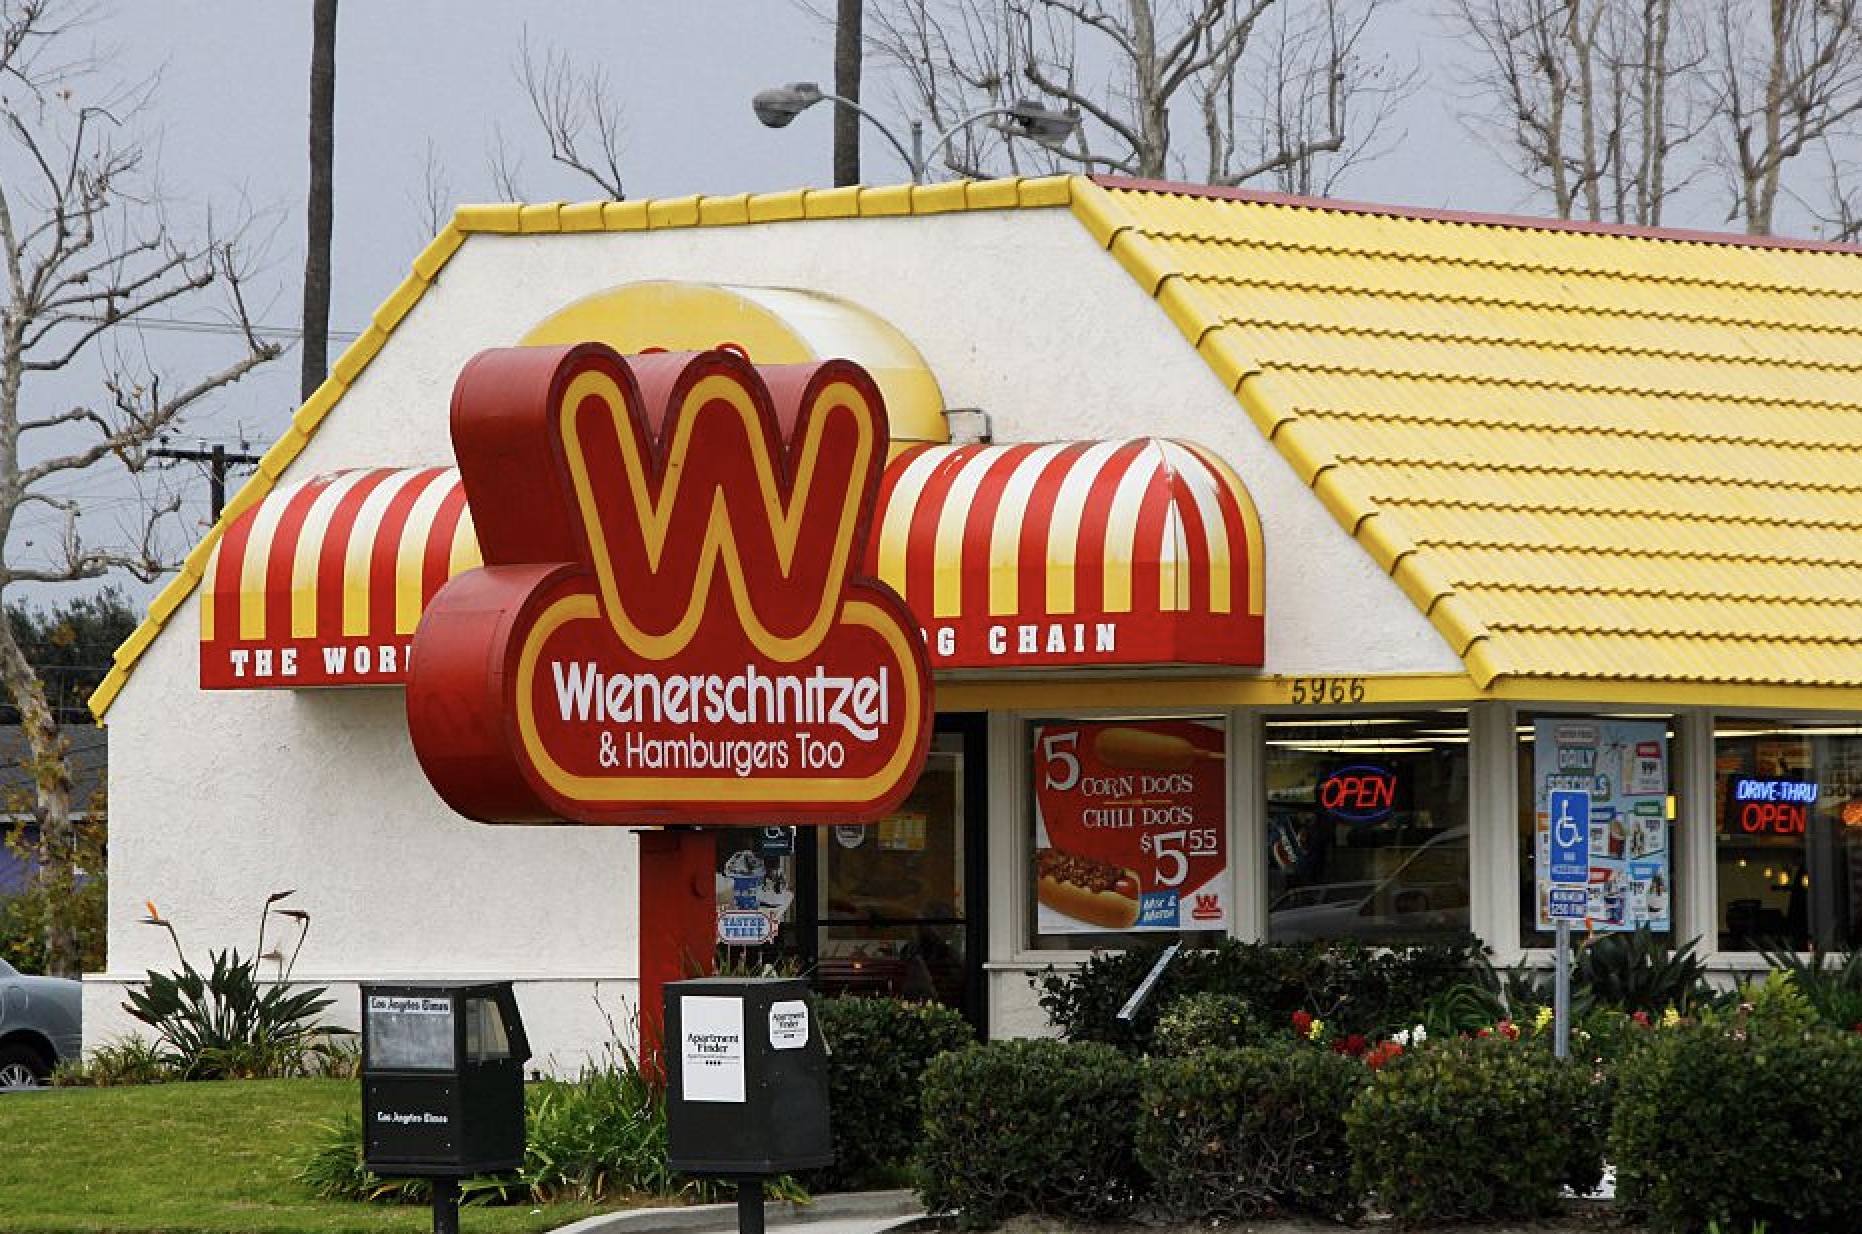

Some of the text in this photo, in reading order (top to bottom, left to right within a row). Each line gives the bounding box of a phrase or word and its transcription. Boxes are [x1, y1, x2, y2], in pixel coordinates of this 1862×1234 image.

[560, 370, 873, 662] W
[919, 623, 1117, 656] G CHAIN
[230, 648, 297, 677] THE
[552, 661, 889, 741] Wienerschnitzel
[1291, 677, 1366, 705] 5966
[600, 731, 845, 776] & Hamburgers Too
[1043, 731, 1081, 791] 5
[1081, 773, 1194, 798] CORN DOGS
[1321, 775, 1396, 809] OPEN
[1737, 780, 1818, 803] DRIVE-THRU
[1083, 805, 1194, 828] CHILI DOGS
[1741, 803, 1807, 833] OPEN
[371, 997, 449, 1012] Los Angeles Times
[687, 1033, 739, 1046] Apartment
[697, 1043, 729, 1053] Finder
[377, 1111, 449, 1124] Los Angeles Times
